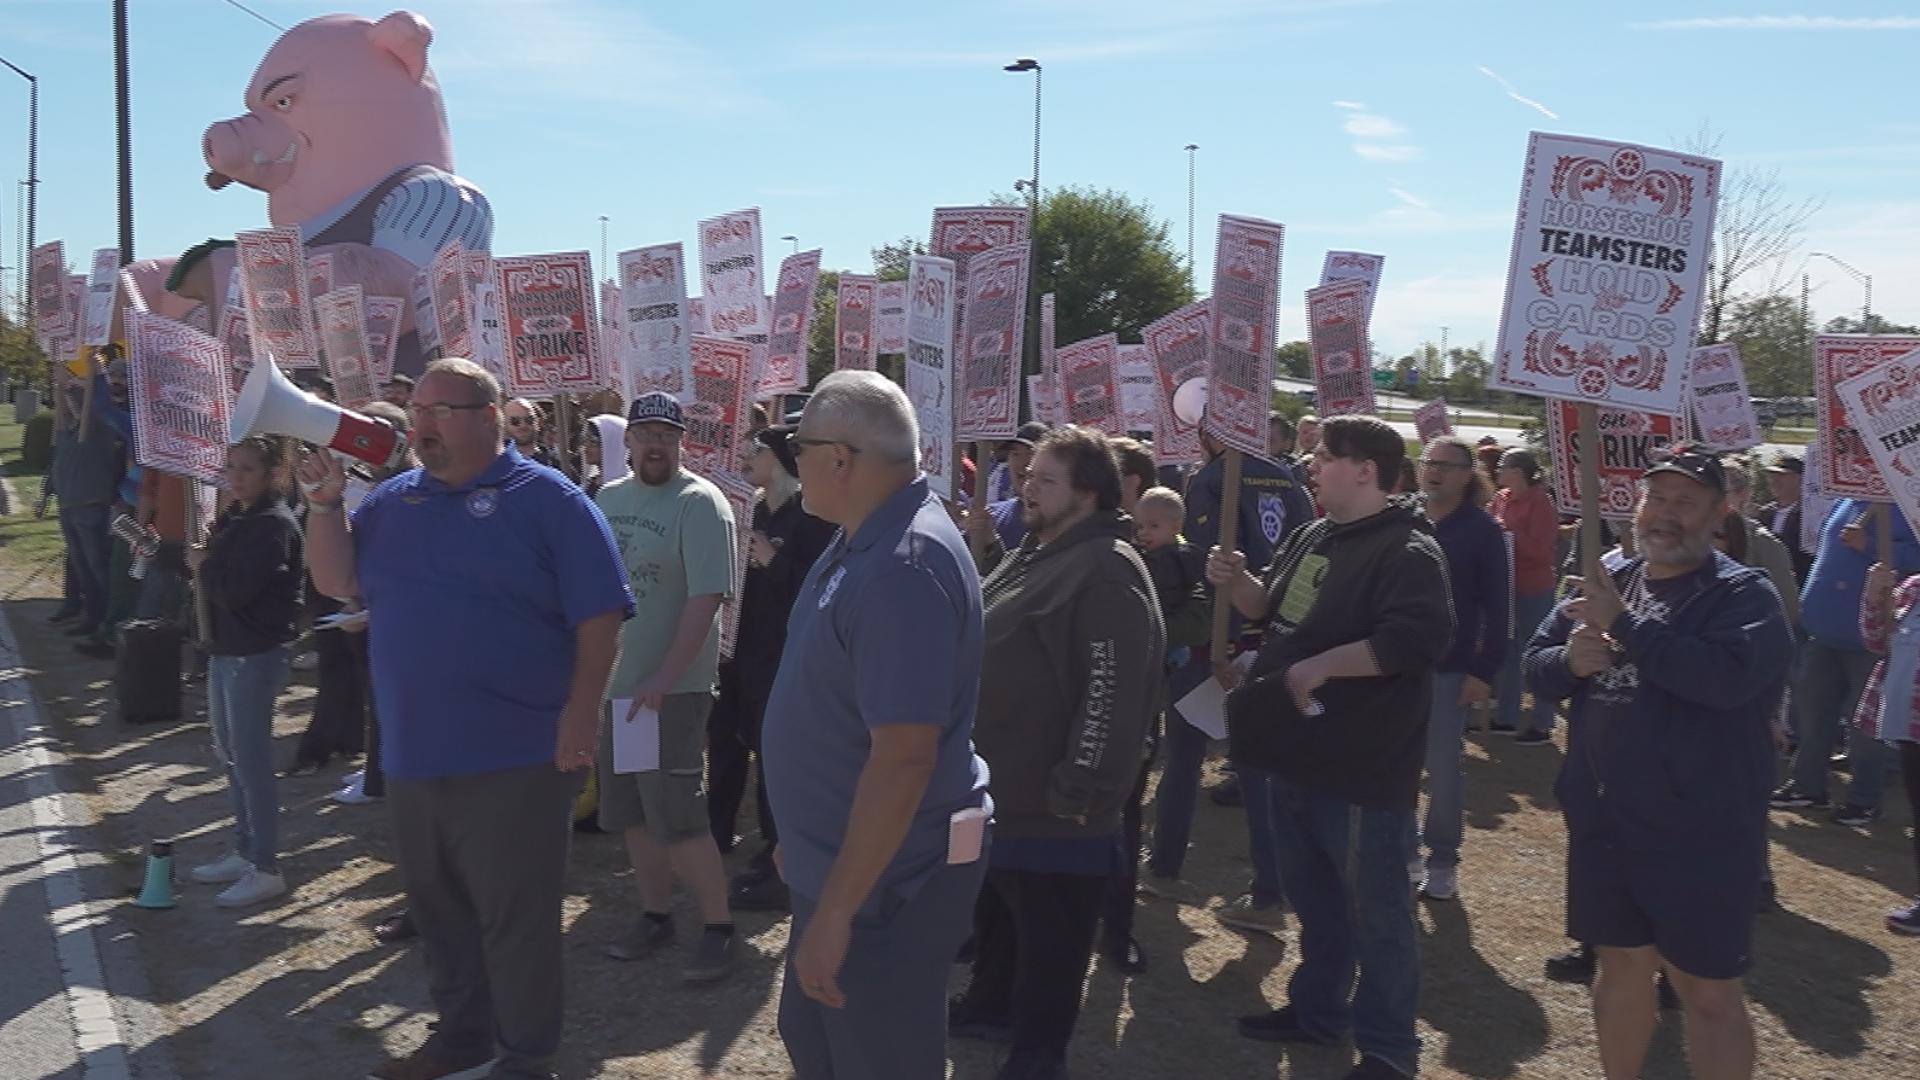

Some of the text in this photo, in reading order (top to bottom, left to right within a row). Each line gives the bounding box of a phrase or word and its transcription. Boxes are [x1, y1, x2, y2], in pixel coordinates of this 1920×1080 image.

[1540, 199, 1693, 247] HORSESHOE
[1539, 228, 1688, 274] TEAMSTERS
[1560, 259, 1660, 305] HOLD
[515, 331, 586, 359] STRIKE
[1525, 300, 1677, 348] CARDS
[1073, 641, 1105, 767] LINCOLN
